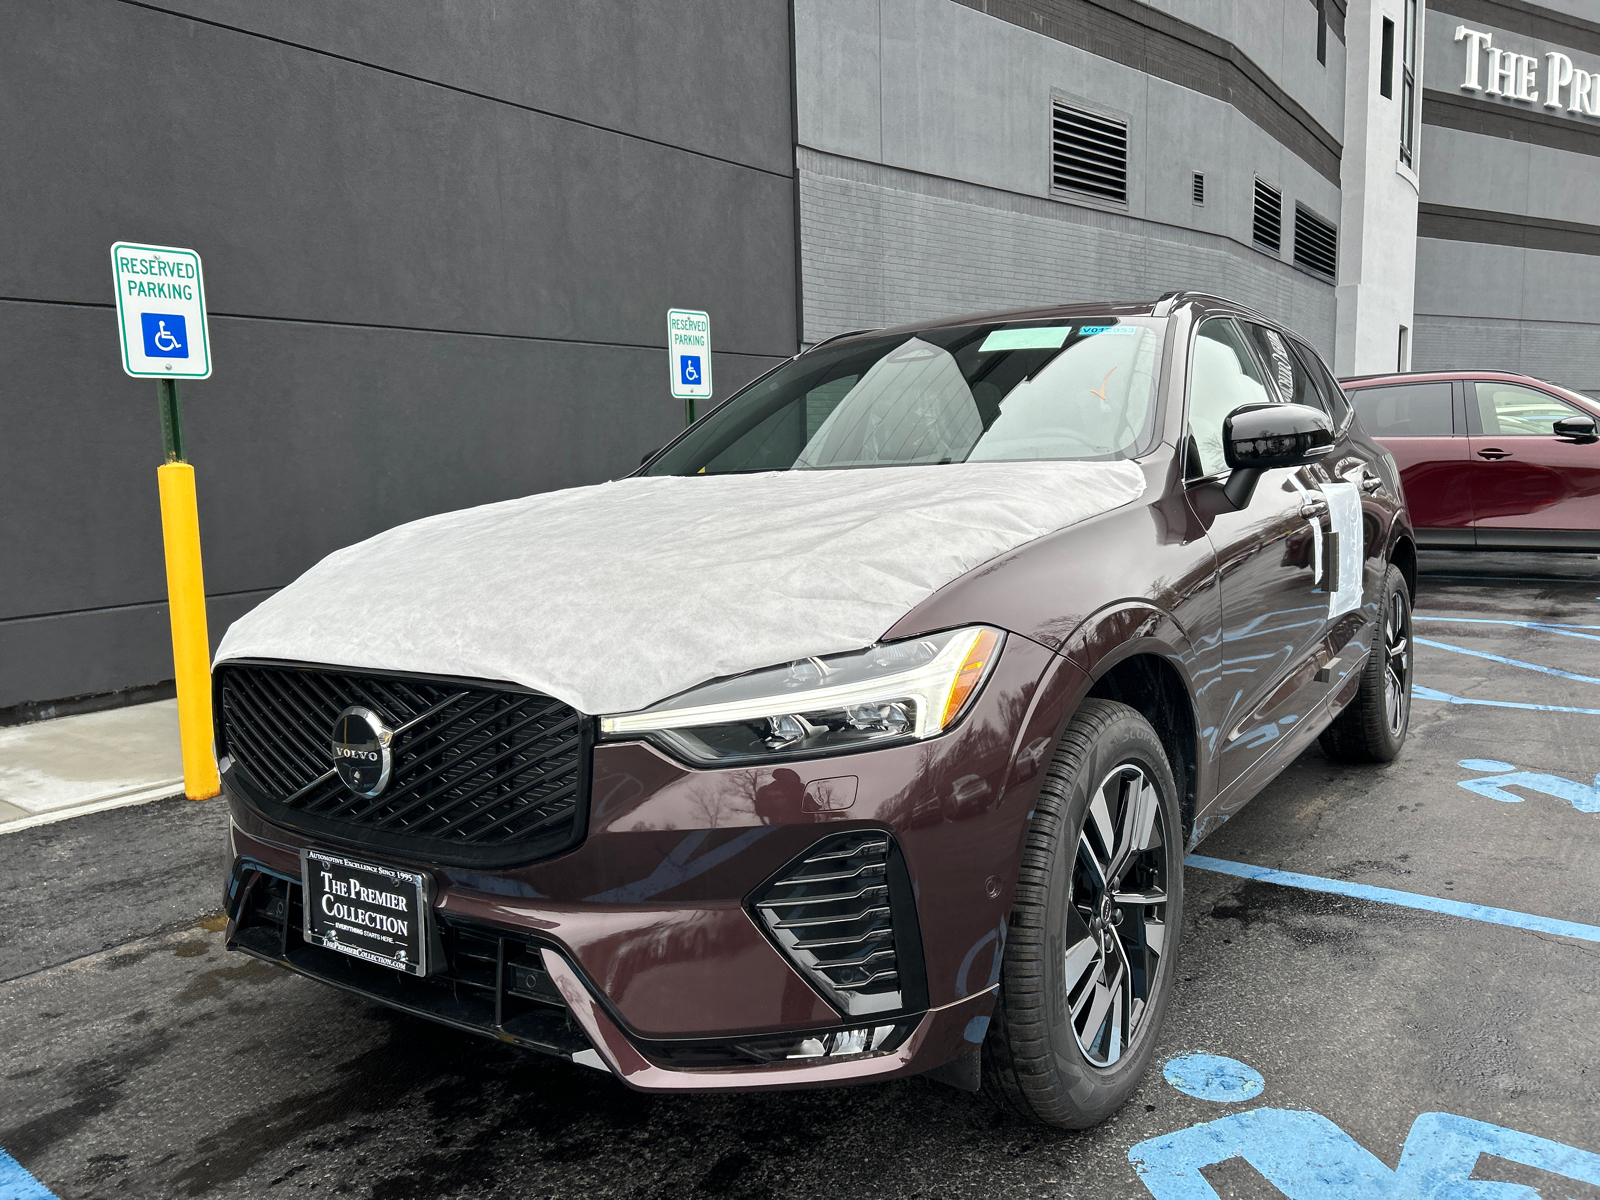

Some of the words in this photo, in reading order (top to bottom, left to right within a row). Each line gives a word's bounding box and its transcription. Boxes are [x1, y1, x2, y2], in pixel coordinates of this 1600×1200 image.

[1454, 24, 1539, 103] THE
[120, 257, 194, 278] RESERVED
[127, 280, 192, 300] PARKING
[671, 319, 706, 331] RESERVED
[674, 334, 705, 346] PARKING
[335, 747, 378, 762] VOLVO
[308, 851, 343, 864] AUTOMOTIVE
[344, 859, 377, 872] EXCELLENCE
[378, 866, 396, 877] SINCE
[396, 871, 413, 882] 1995
[320, 871, 349, 898] THE
[349, 878, 408, 912] PREMIER
[321, 893, 408, 937] COLLECTION
[335, 922, 363, 936] EVERYTHING
[363, 930, 380, 940] STARTS
